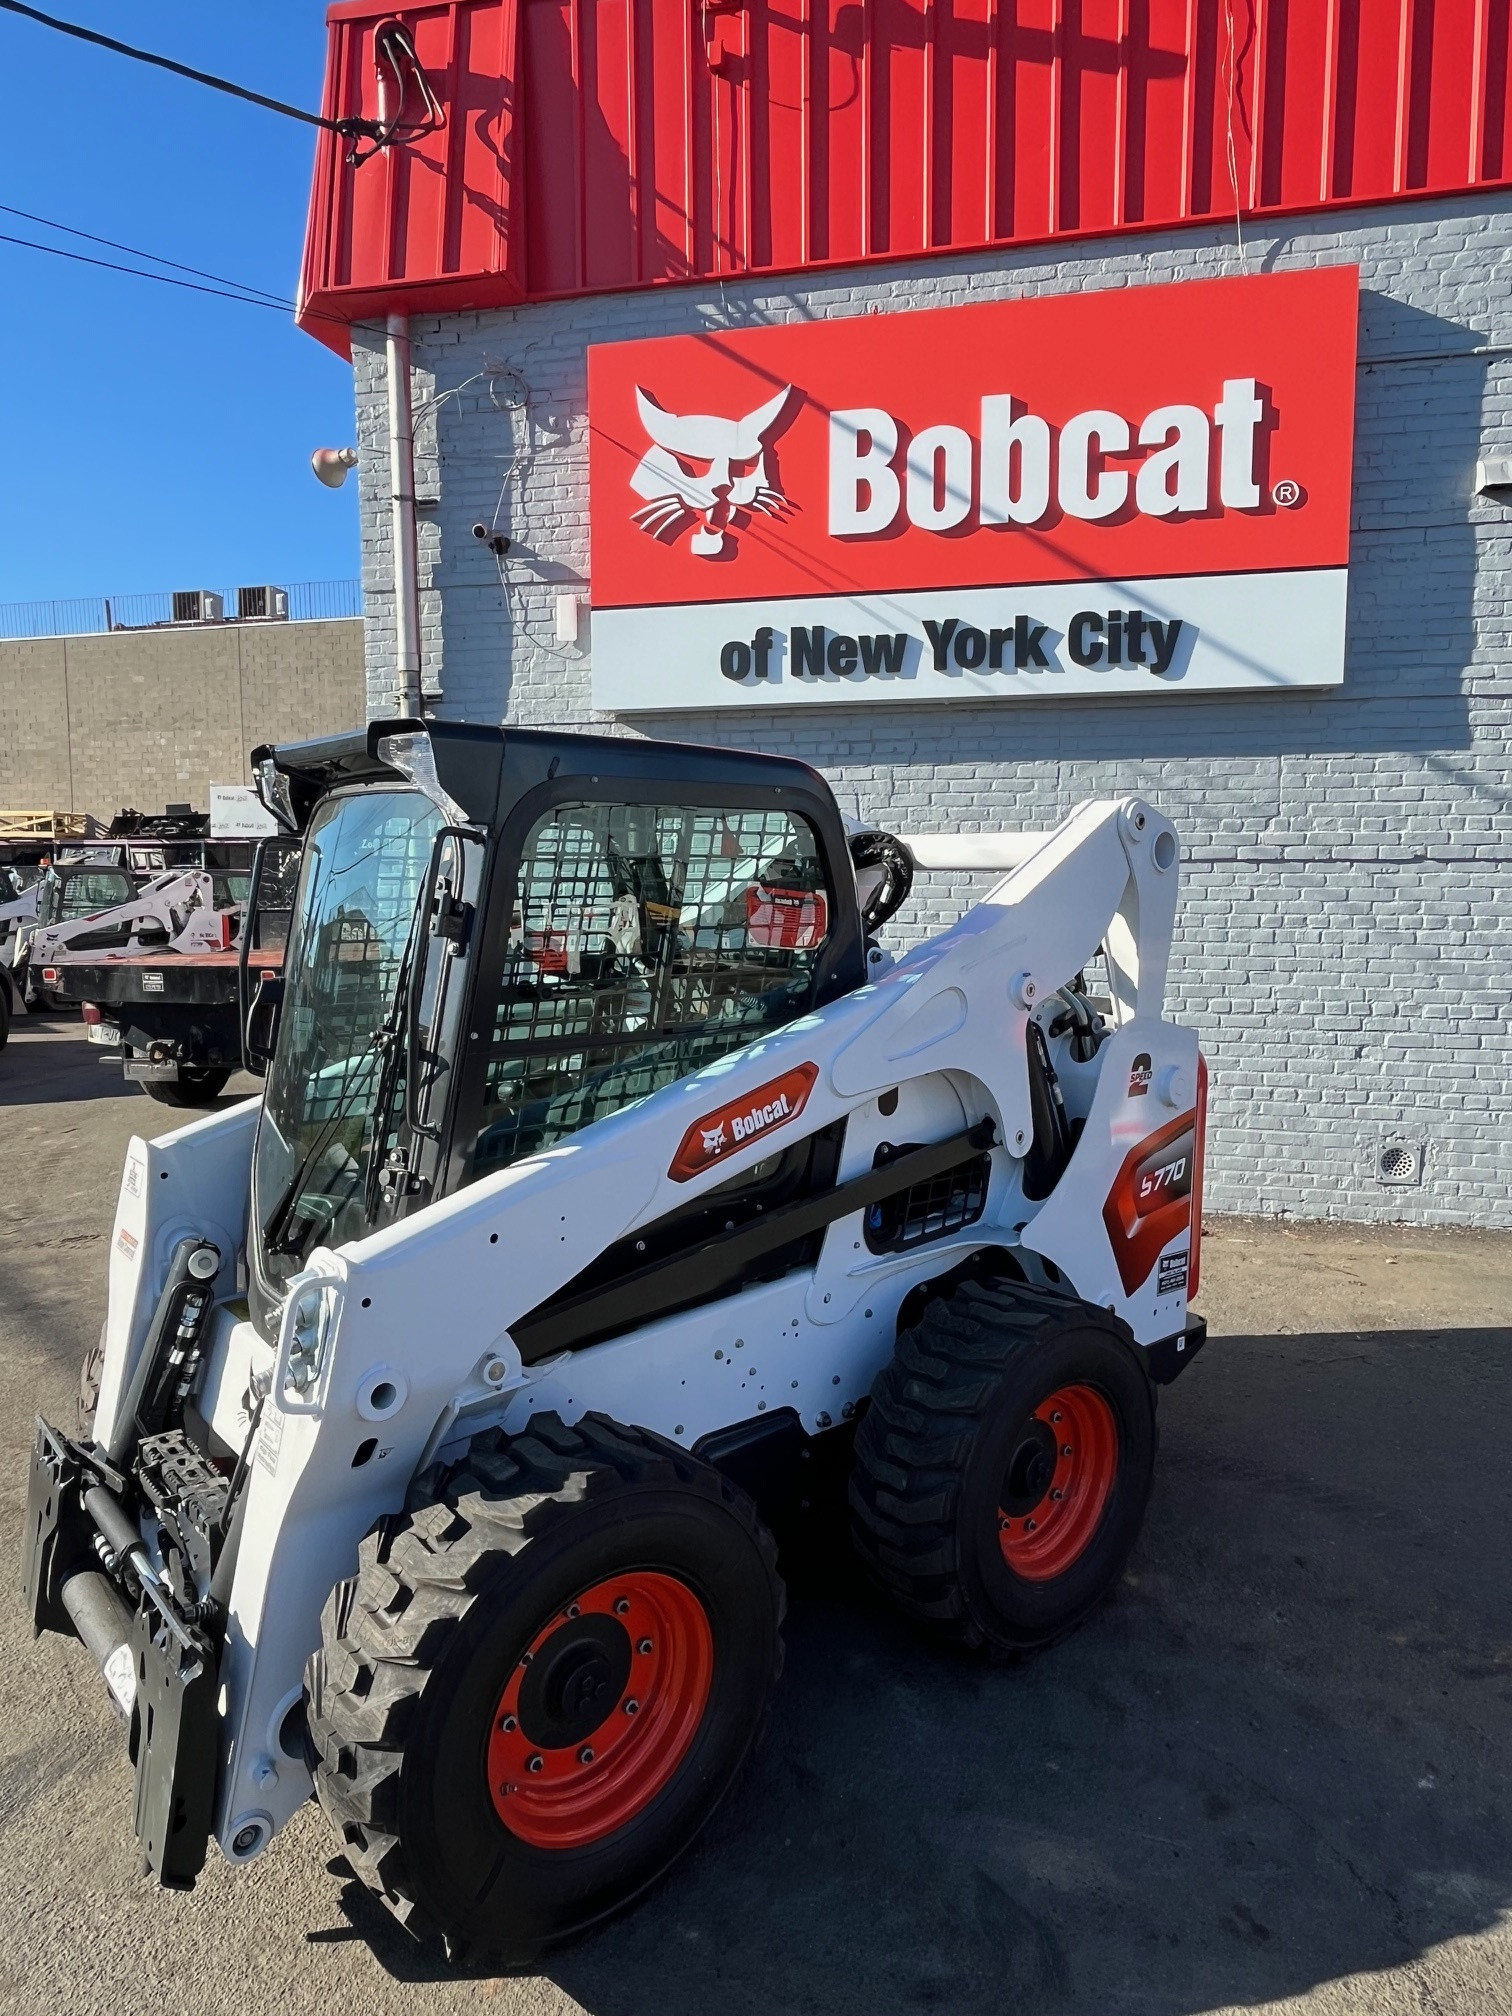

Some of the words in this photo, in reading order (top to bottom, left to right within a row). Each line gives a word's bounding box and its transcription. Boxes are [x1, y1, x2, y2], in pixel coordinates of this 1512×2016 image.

[828, 377, 1263, 536] Bobcat
[720, 626, 774, 681] of
[790, 625, 908, 676] New
[921, 615, 1050, 672] York
[1067, 609, 1184, 674] City
[1130, 1070, 1153, 1083] SPEED
[731, 1093, 790, 1142] Bobcat
[1140, 1157, 1186, 1198] S770
